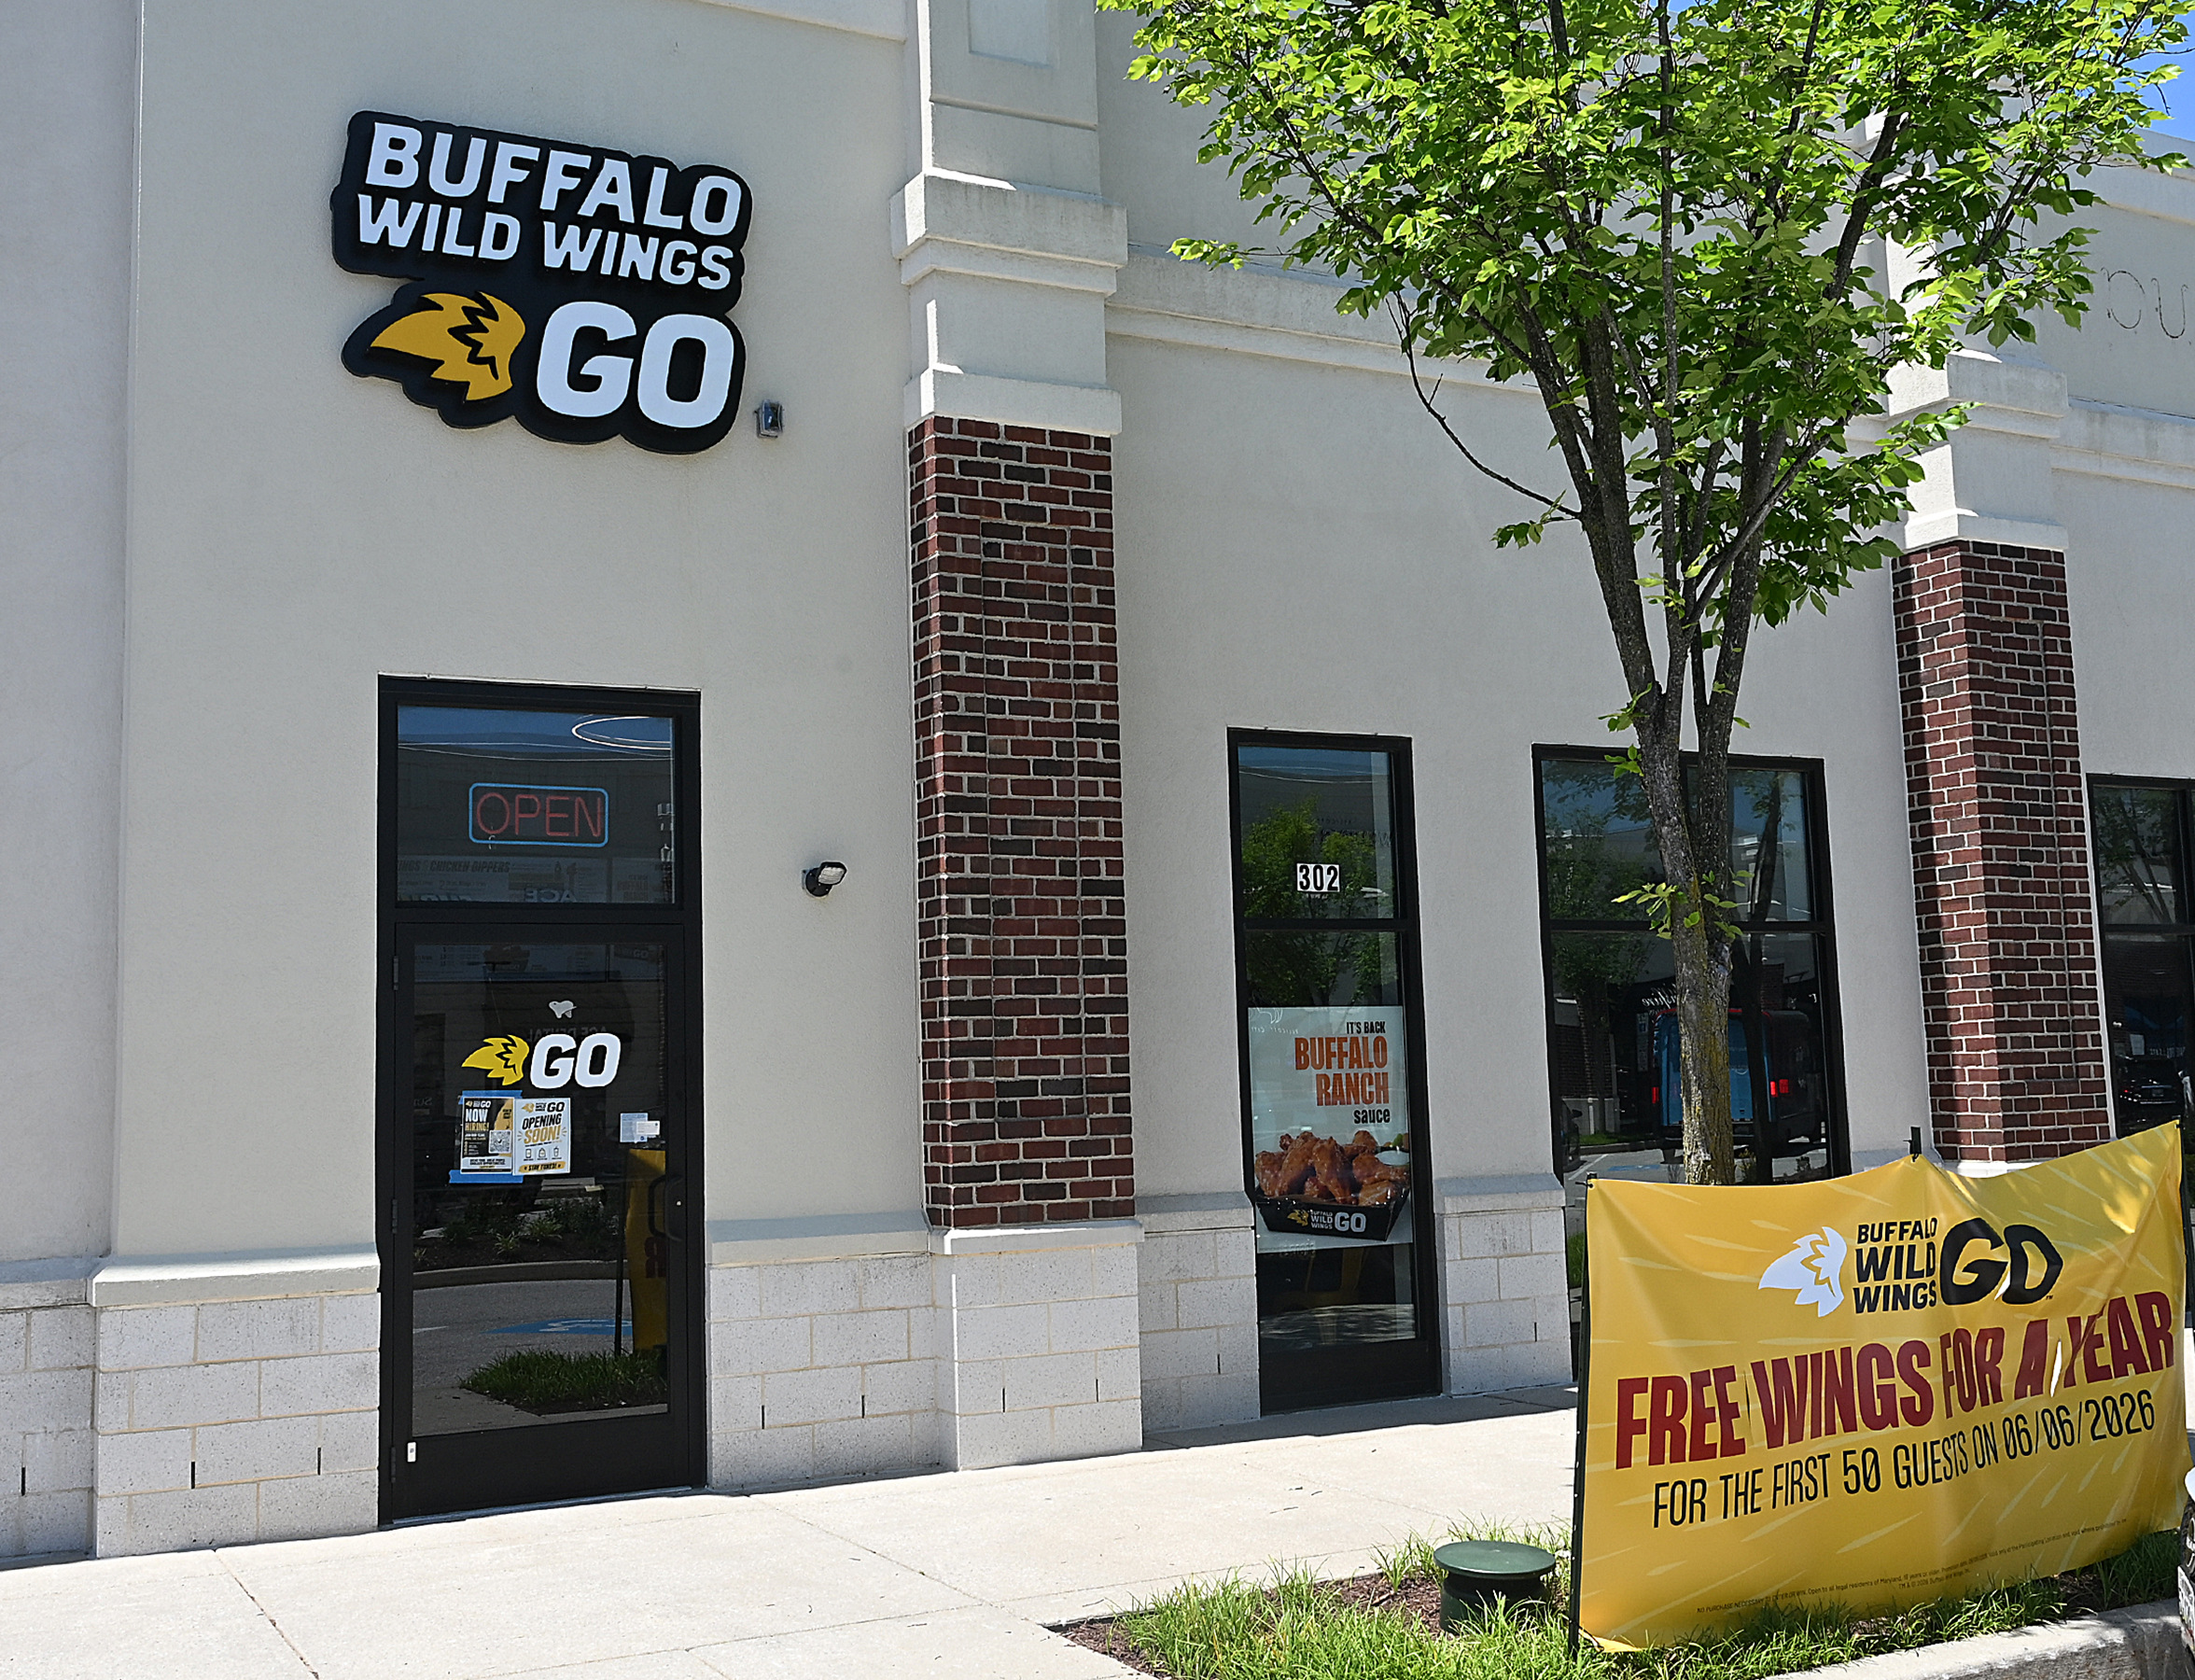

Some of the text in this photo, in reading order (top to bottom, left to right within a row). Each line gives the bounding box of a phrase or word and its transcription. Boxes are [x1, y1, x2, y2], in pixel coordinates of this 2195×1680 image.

[365, 121, 742, 236] BUFFALO
[357, 193, 734, 290] WILD WINGS
[536, 301, 734, 427] GO
[476, 792, 601, 837] OPEN
[1299, 864, 1338, 890] 302
[1346, 1020, 1386, 1034] IT'S BACK
[530, 1032, 621, 1089] GO
[1294, 1035, 1388, 1070] BUFFALO
[1316, 1072, 1390, 1106] RANCH
[465, 1109, 488, 1122] NOW
[547, 1101, 565, 1113] GO
[1353, 1109, 1391, 1124] sauce
[465, 1122, 490, 1131] HIRING!
[522, 1113, 562, 1130] OPENING
[524, 1125, 561, 1144] SOON!
[1310, 1215, 1334, 1224] WILD
[1311, 1222, 1333, 1230] WINGS
[1335, 1211, 1366, 1232] GO
[1856, 1217, 1938, 1245] BUFFALO
[1853, 1243, 1936, 1283] WILD
[1852, 1280, 1937, 1314] WINGS
[1615, 1290, 2175, 1469] FREE WINGS FOR A YEAR
[1654, 1389, 2155, 1528] FOR THE FIRST 50 GUESTS ON 06/06/2026
[1706, 1603, 1733, 1613] PURCHASE
